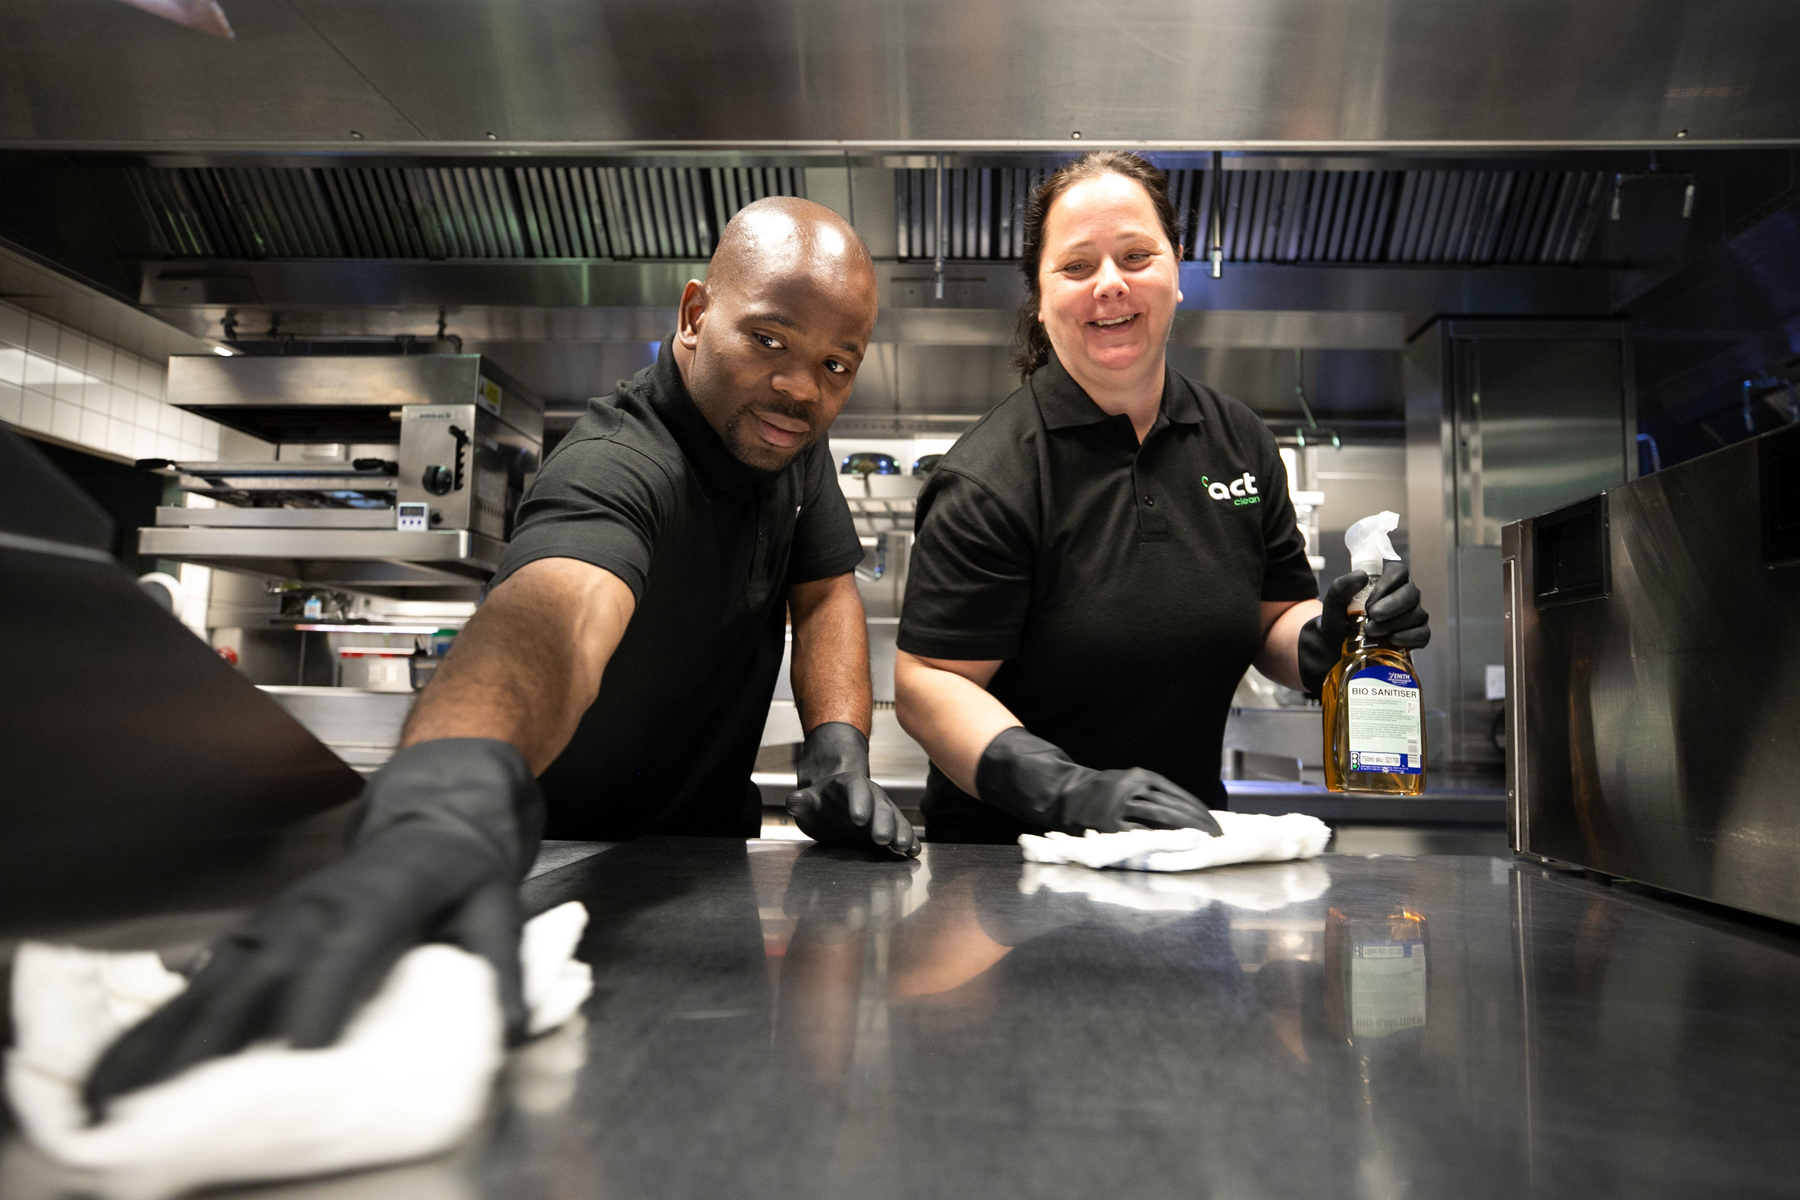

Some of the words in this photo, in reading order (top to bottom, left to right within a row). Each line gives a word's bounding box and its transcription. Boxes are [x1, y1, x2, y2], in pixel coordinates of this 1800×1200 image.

[1208, 472, 1258, 500] act
[1233, 496, 1260, 506] clean
[1388, 672, 1410, 680] ZENITH
[1352, 687, 1368, 695] BIO
[1371, 688, 1417, 698] SANITISER
